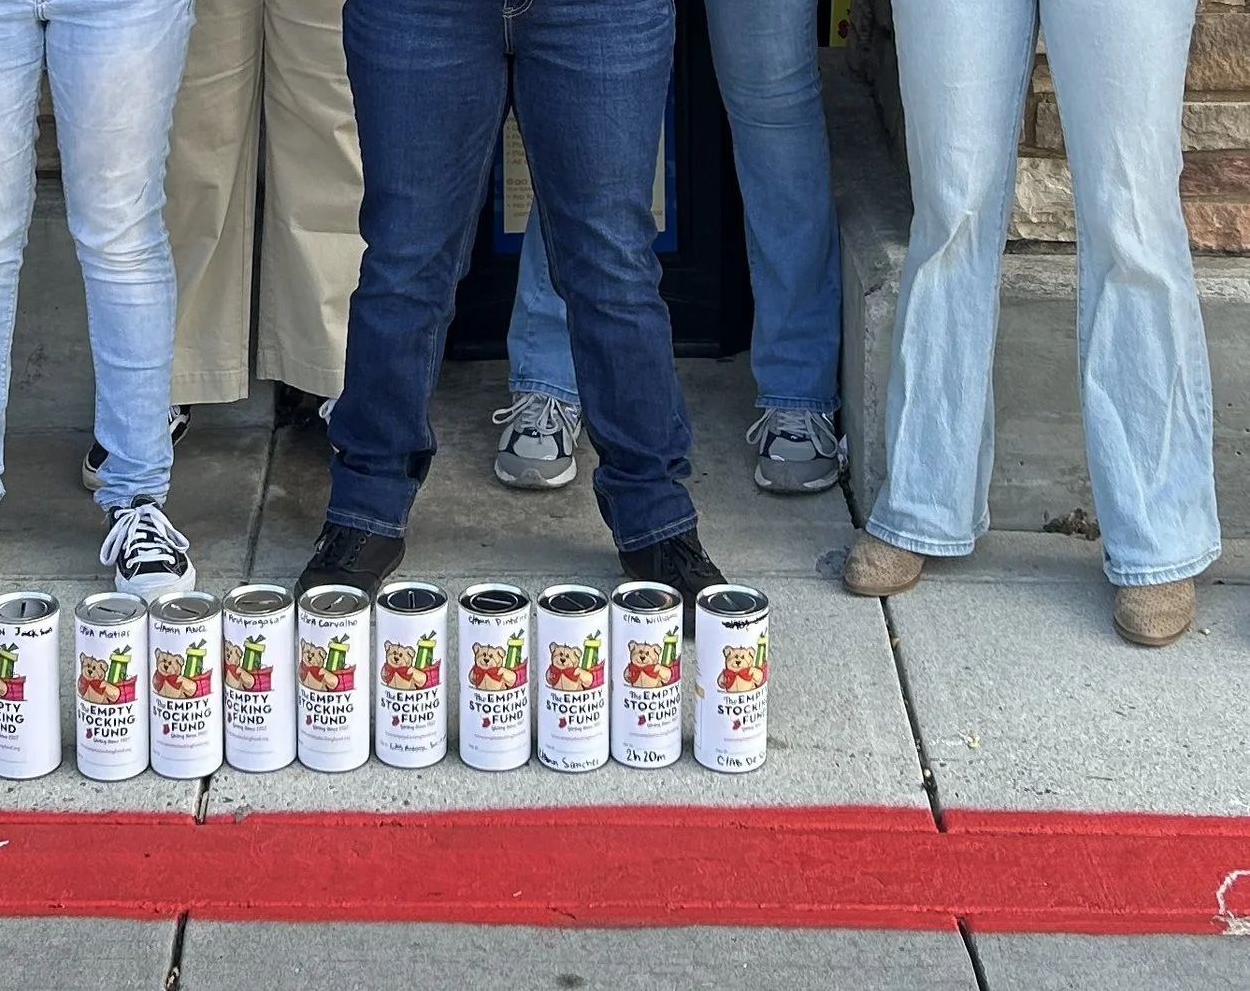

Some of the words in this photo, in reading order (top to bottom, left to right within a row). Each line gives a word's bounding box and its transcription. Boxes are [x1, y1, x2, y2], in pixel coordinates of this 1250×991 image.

[229, 690, 269, 704] EMPTY
[310, 692, 351, 704] EMPTY
[397, 688, 438, 702] EMPTY
[487, 687, 526, 703] EMPTY
[563, 688, 603, 703] EMPTY
[643, 682, 679, 700] EMPTY
[166, 698, 209, 711] EMPTY
[299, 695, 354, 715] STOCKING
[381, 697, 440, 713] STOCKING
[469, 696, 528, 714] STOCKING
[546, 698, 605, 714] STOCKING
[624, 693, 681, 712] STOCKING
[90, 704, 133, 716] EMPTY
[153, 706, 211, 722] STOCKING
[401, 711, 434, 723] FUND
[492, 710, 523, 724] FUND
[648, 707, 677, 721] FUND
[233, 712, 264, 725] FUND
[313, 714, 347, 725] FUND
[568, 711, 600, 725] FUND
[94, 727, 128, 737] FUND
[171, 721, 205, 732] FUND
